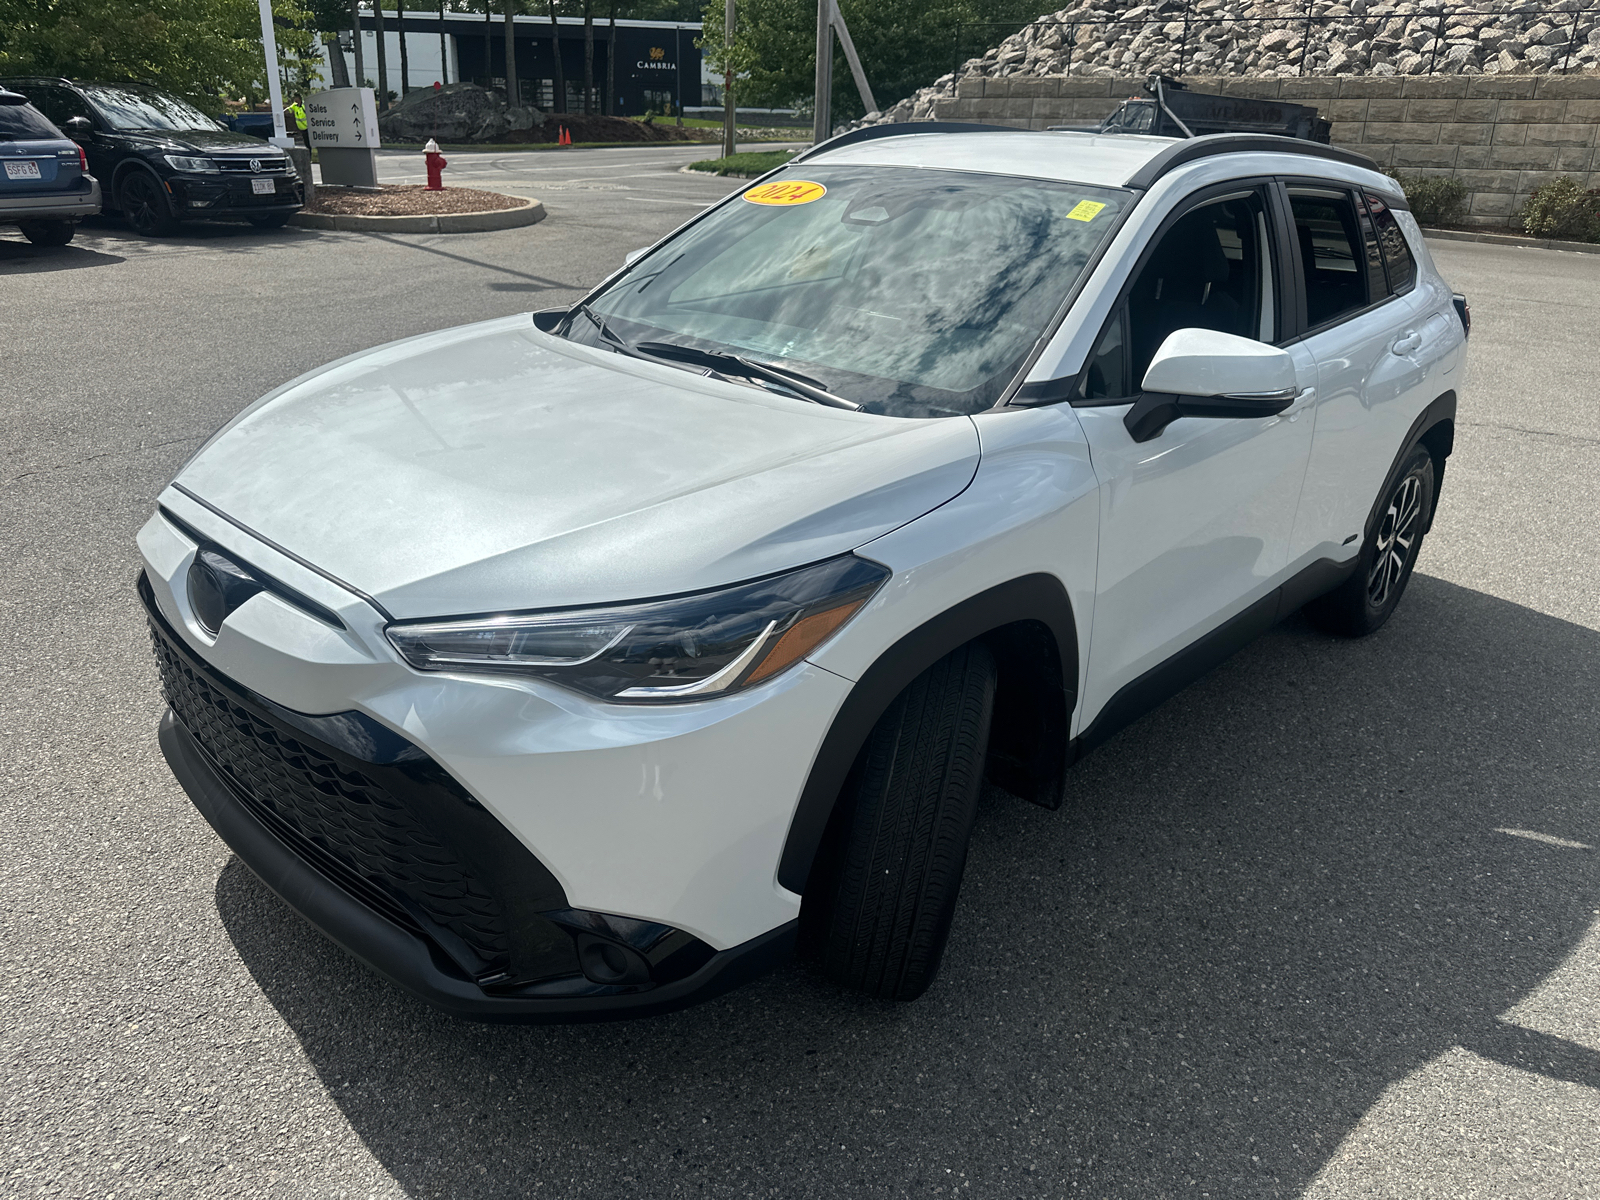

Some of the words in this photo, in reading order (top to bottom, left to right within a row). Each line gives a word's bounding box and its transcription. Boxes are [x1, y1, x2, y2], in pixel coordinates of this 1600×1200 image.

[636, 60, 677, 70] CAMBRIA
[308, 103, 328, 114] Sales
[310, 117, 336, 127] Service
[312, 130, 339, 142] Delivery
[748, 184, 819, 201] 2024
